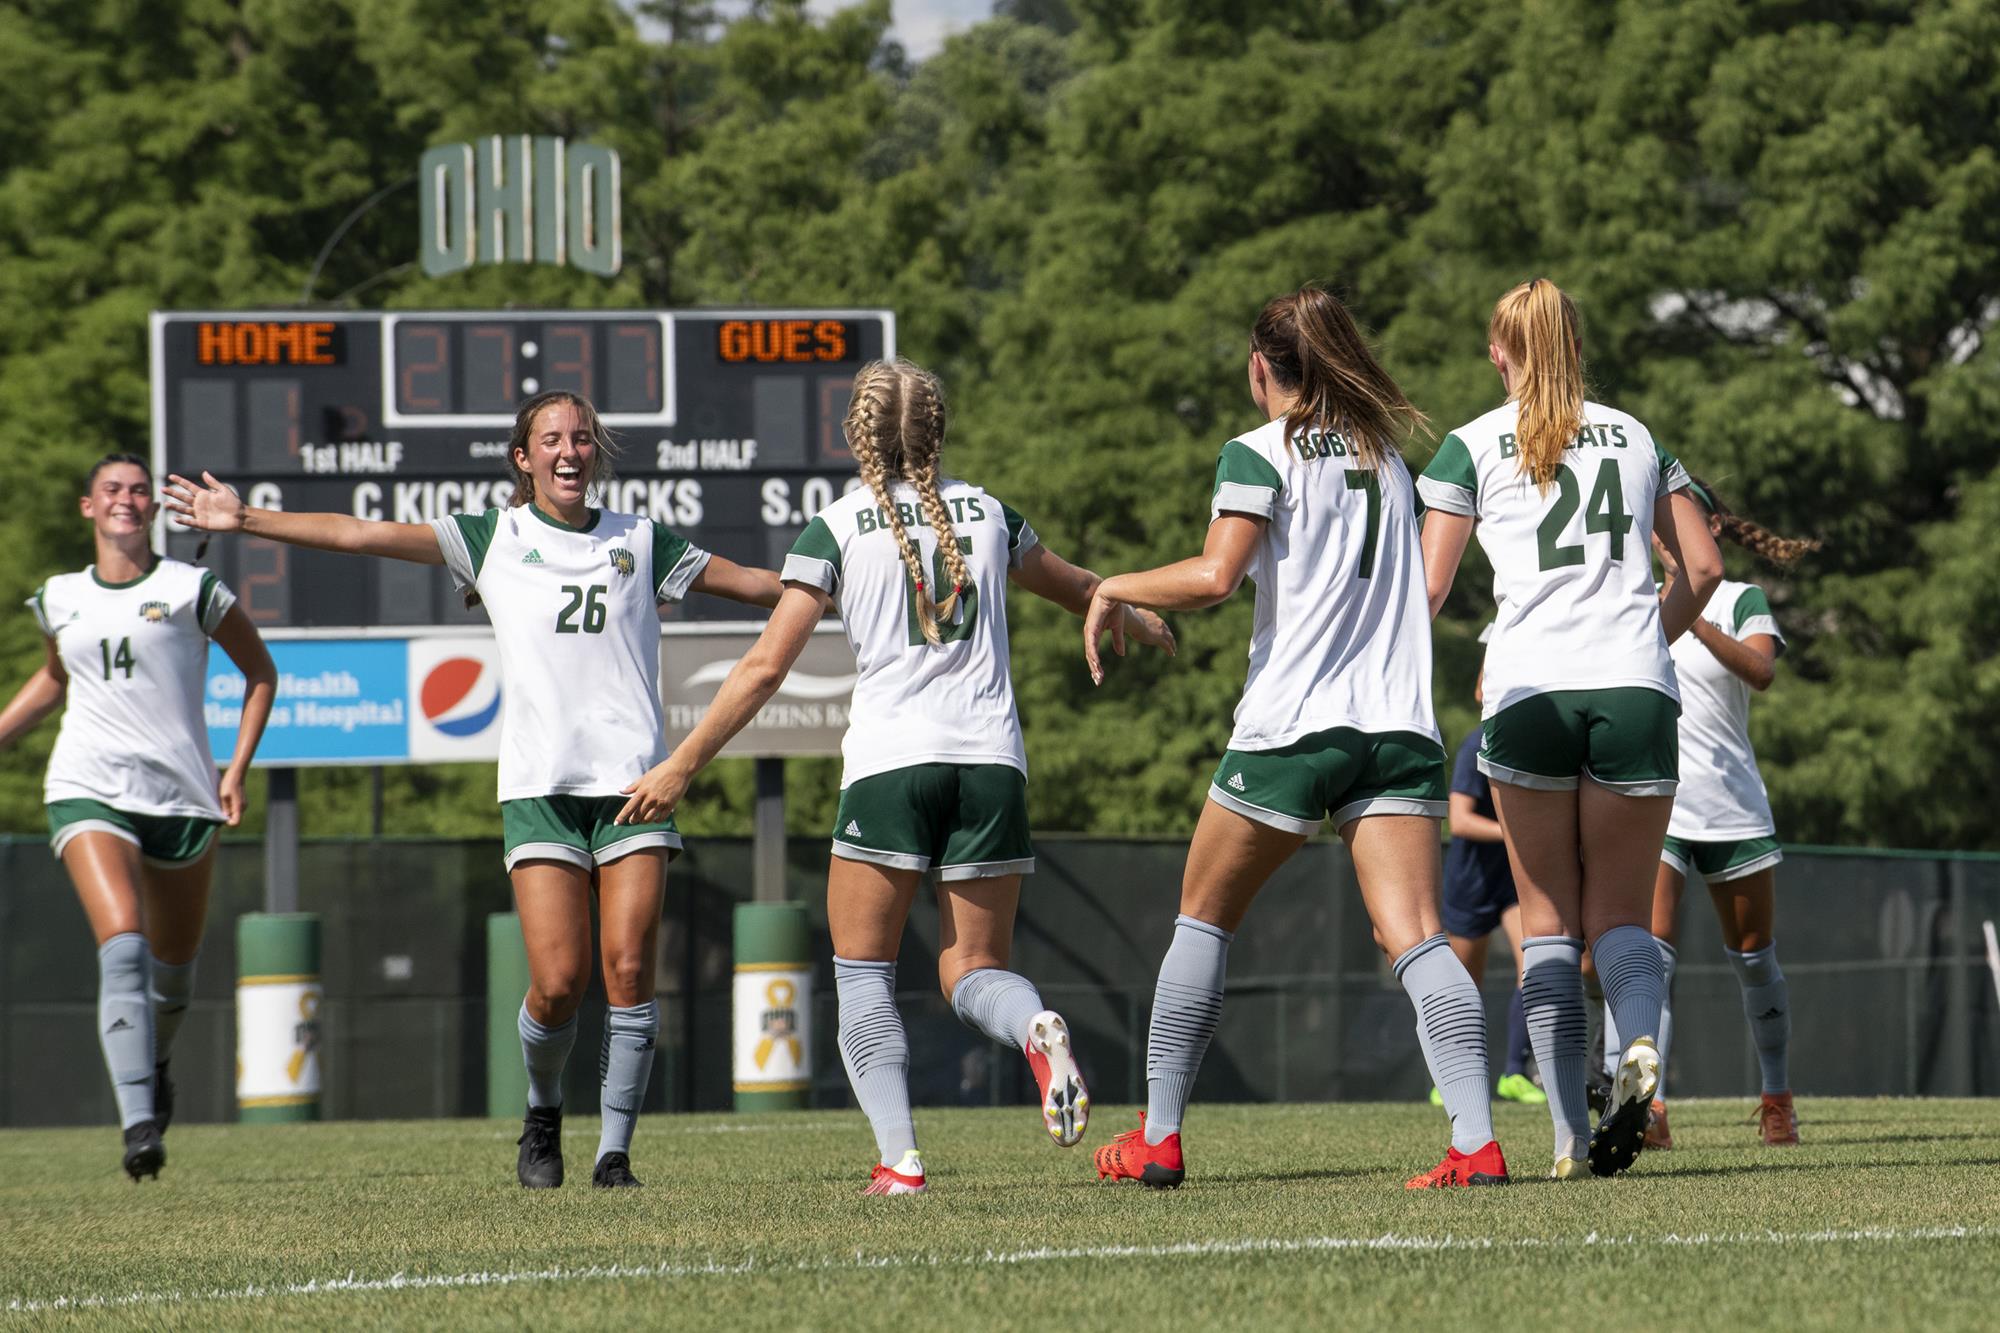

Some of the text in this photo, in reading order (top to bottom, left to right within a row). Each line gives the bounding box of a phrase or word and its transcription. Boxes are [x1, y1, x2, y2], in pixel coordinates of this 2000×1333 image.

[420, 134, 622, 277] OHIO
[198, 322, 336, 365] HOME
[718, 320, 847, 362] GUES
[300, 441, 404, 474] 1st HALF
[656, 438, 758, 471] 2nd HALF
[1344, 469, 1382, 579] 7
[1530, 458, 1634, 573] 24
[555, 584, 608, 634] 26
[100, 636, 136, 681] 14
[295, 698, 403, 732] Hospital
